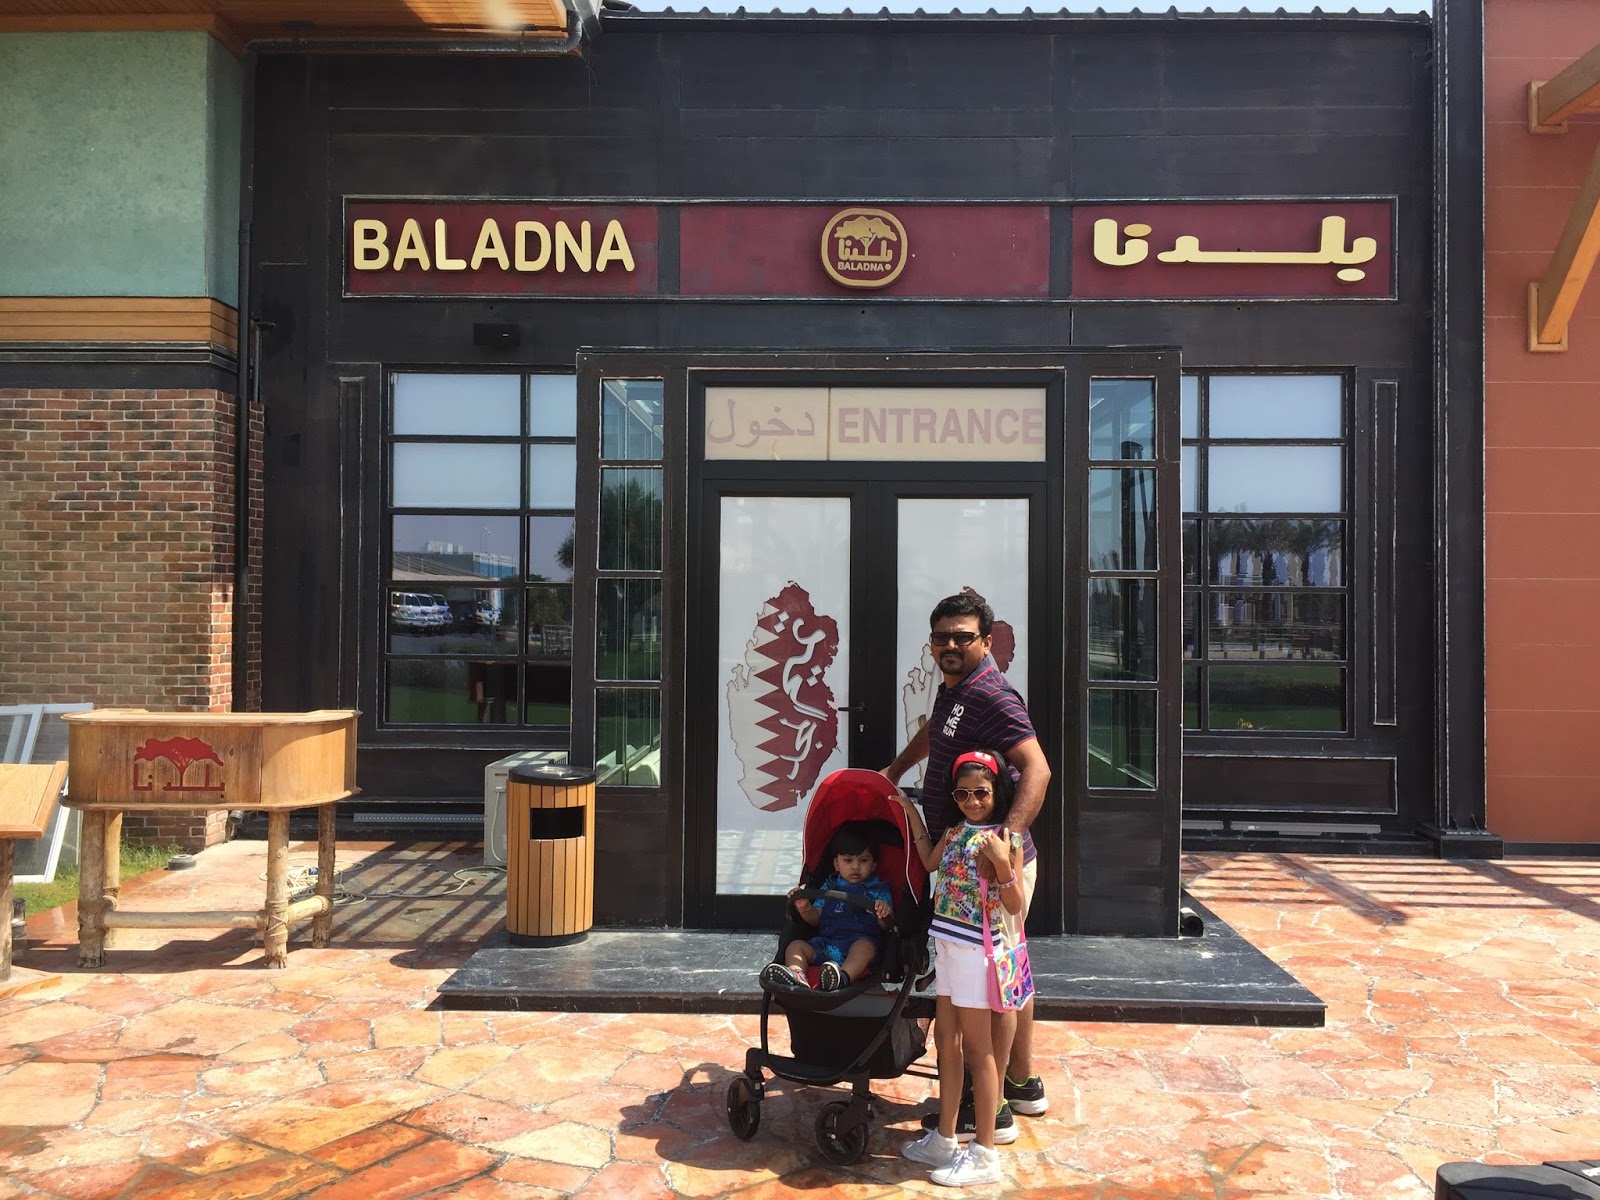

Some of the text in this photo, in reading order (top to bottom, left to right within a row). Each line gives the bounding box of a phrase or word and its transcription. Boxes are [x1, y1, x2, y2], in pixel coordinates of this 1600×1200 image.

[352, 218, 636, 273] BALADNA
[837, 261, 885, 272] BALADNA
[1093, 215, 1377, 282] بلدنا
[706, 398, 816, 449] دخول
[838, 408, 1044, 445] ENTRANCE
